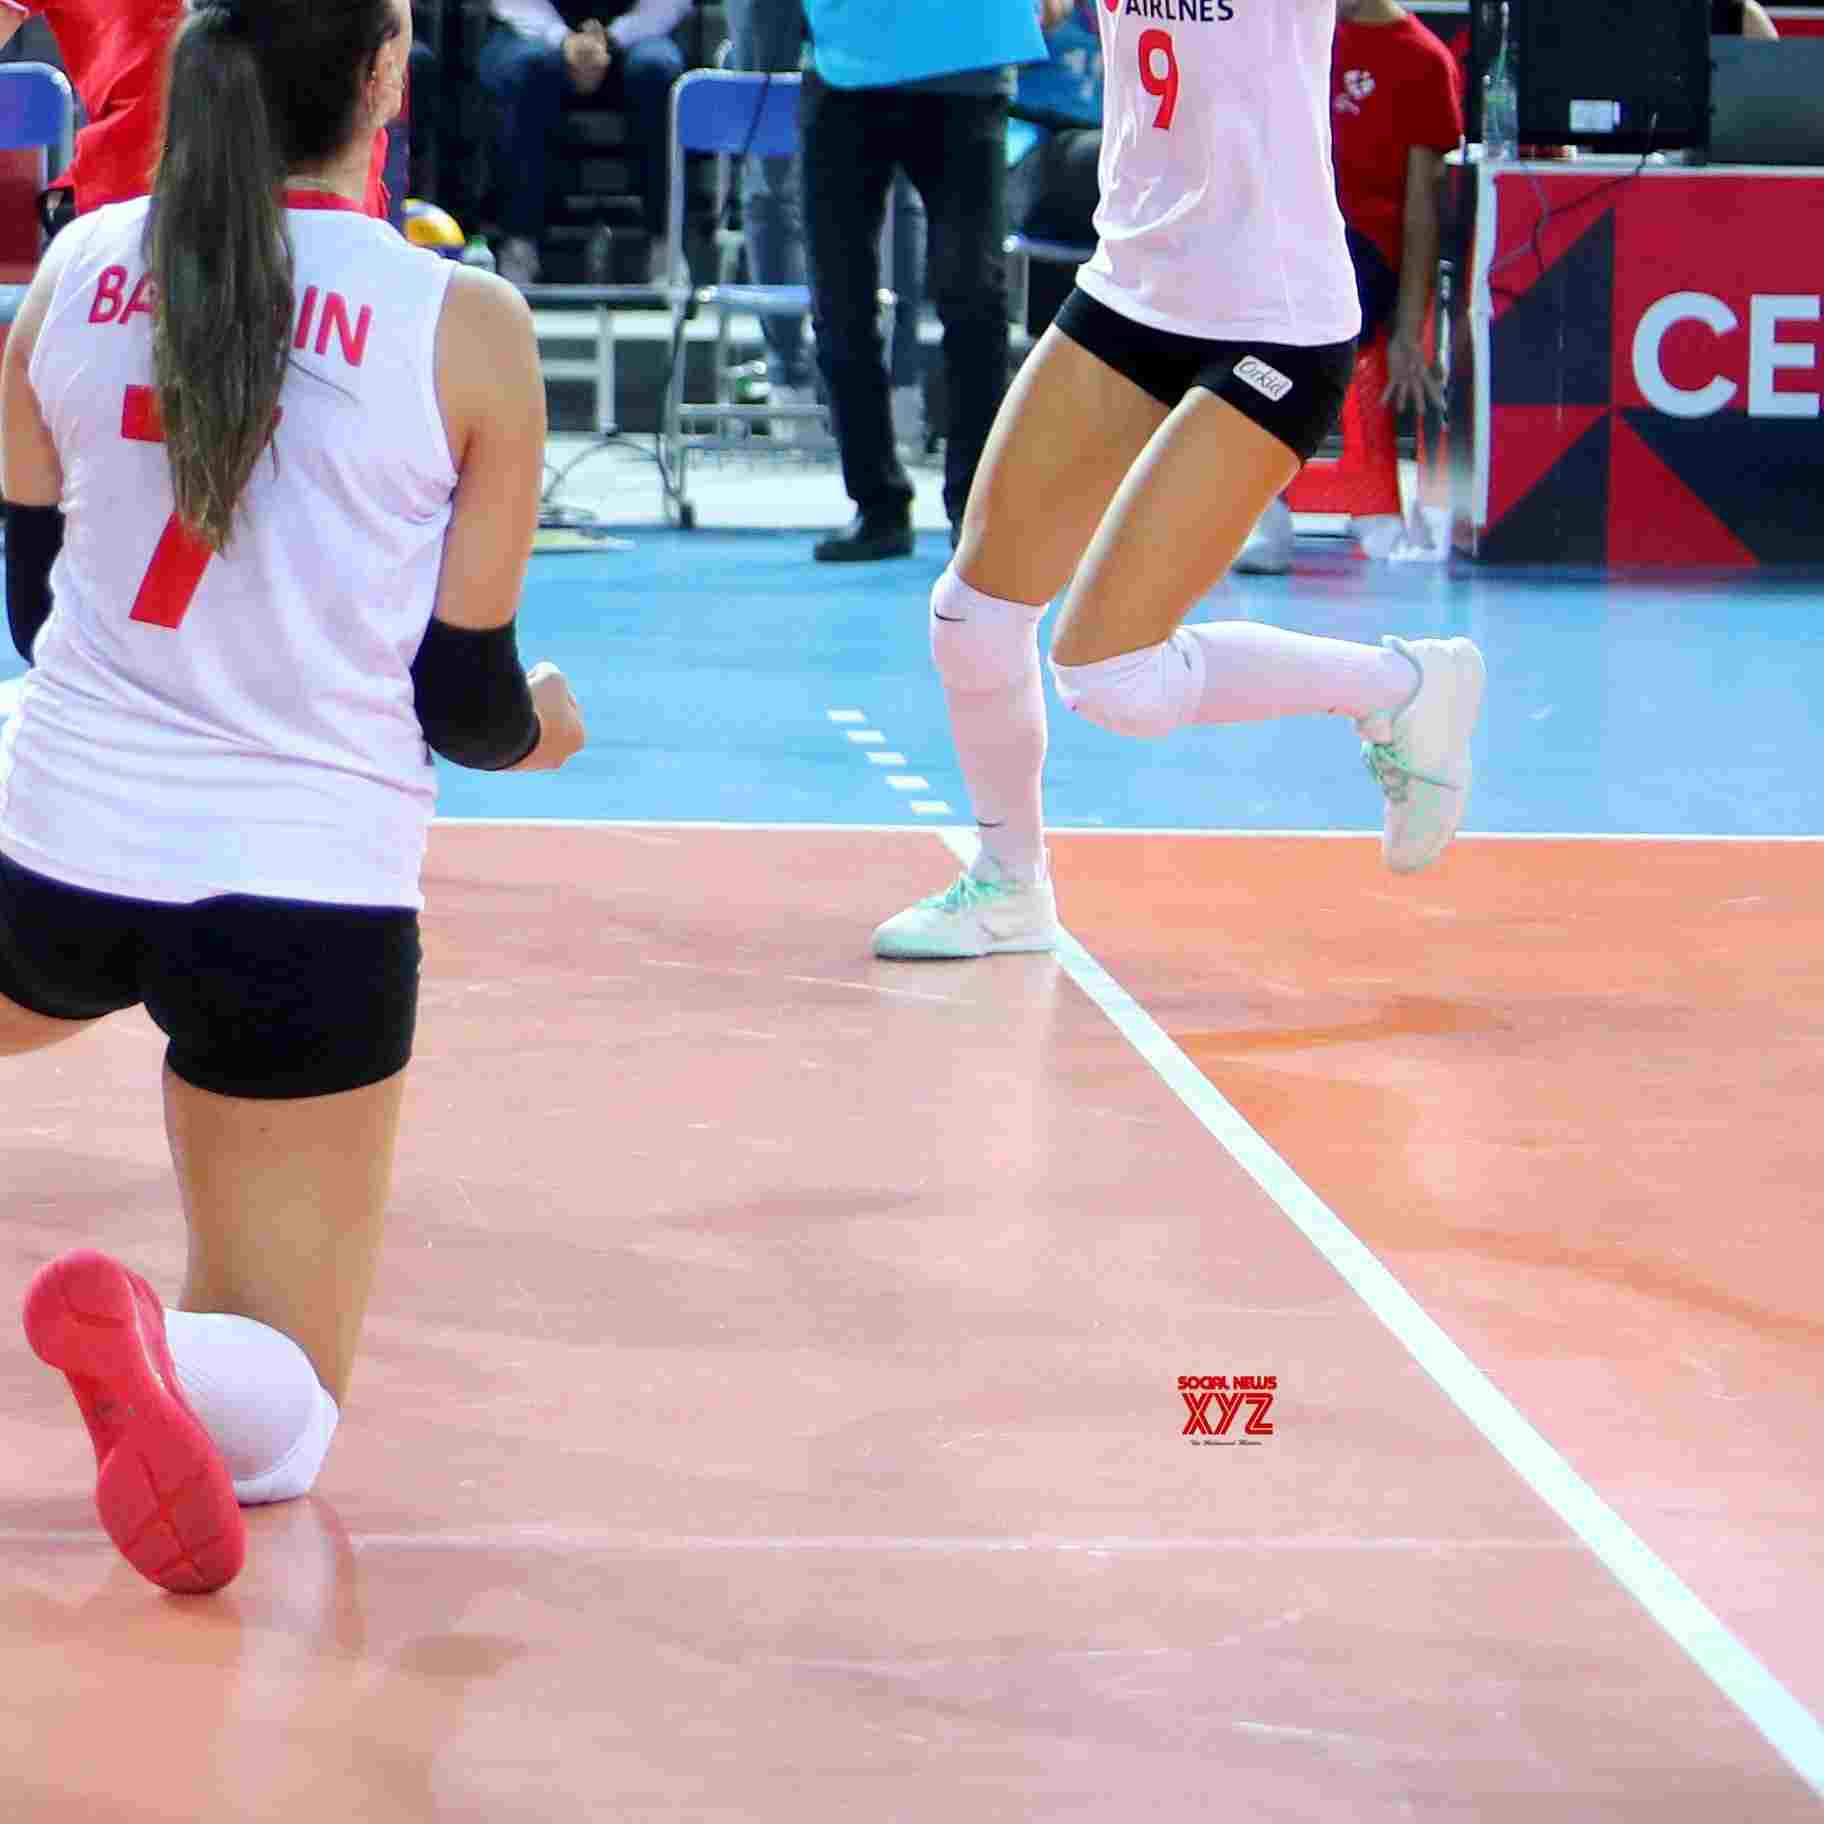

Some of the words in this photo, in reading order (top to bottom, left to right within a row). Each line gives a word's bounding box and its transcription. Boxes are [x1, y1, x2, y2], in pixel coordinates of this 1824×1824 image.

[1138, 28, 1180, 131] 9
[89, 264, 373, 368] BAIN
[1632, 289, 1822, 419] CE
[1238, 360, 1290, 397] Orkid
[122, 385, 283, 629] 7
